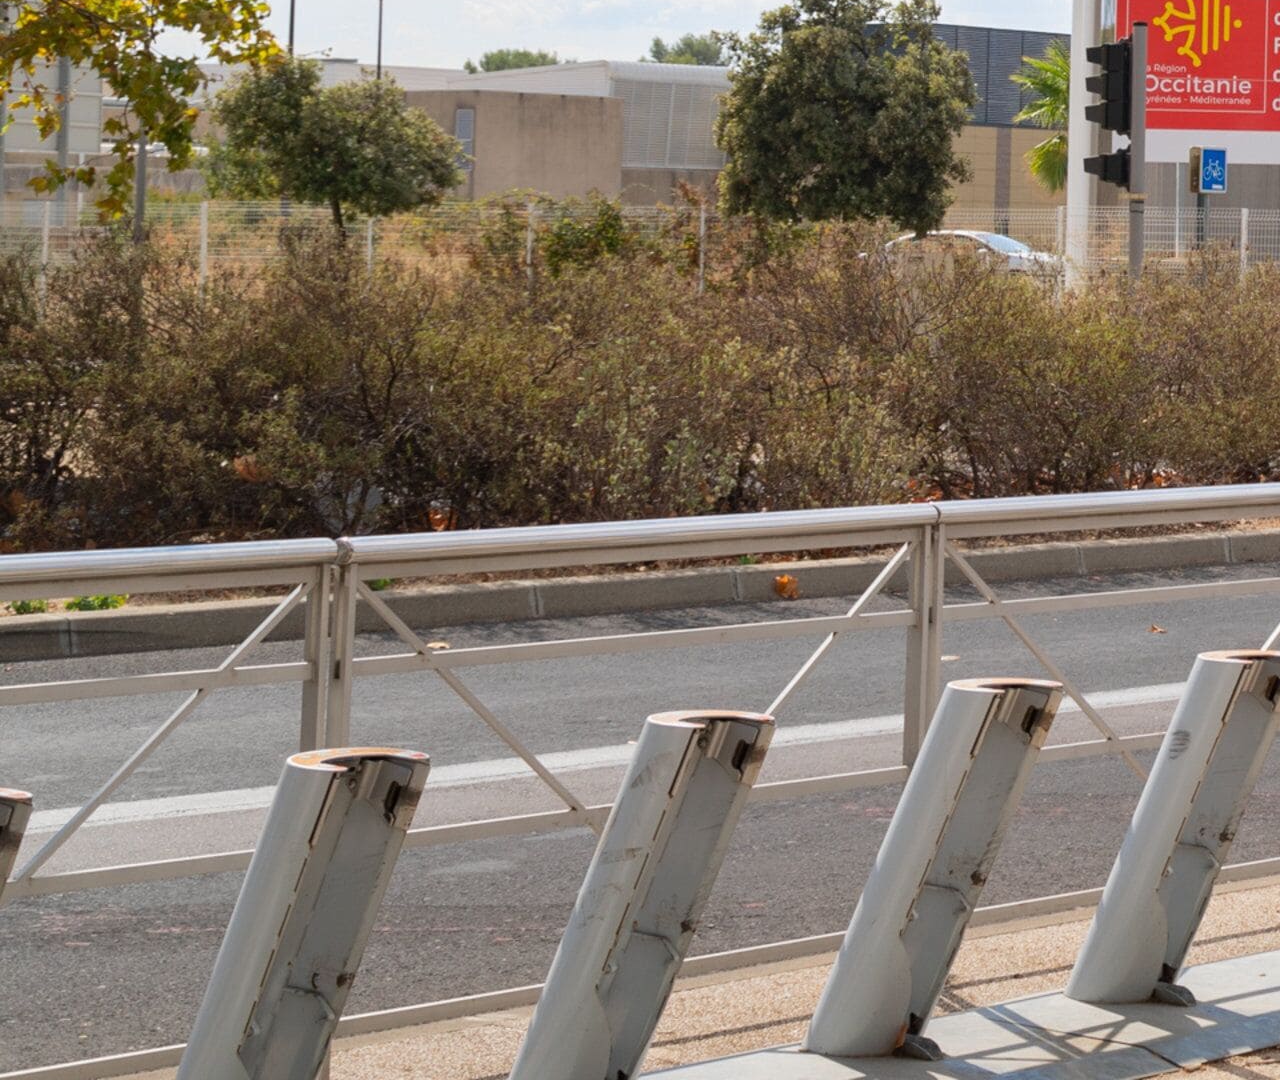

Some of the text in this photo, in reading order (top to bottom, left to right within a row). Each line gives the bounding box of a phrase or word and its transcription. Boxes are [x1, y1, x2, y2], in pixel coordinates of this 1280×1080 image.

[1153, 63, 1187, 74] Région
[1145, 74, 1252, 94] Occitanie
[1145, 93, 1182, 105] yrénées
[1189, 95, 1252, 105] Méditerranée
